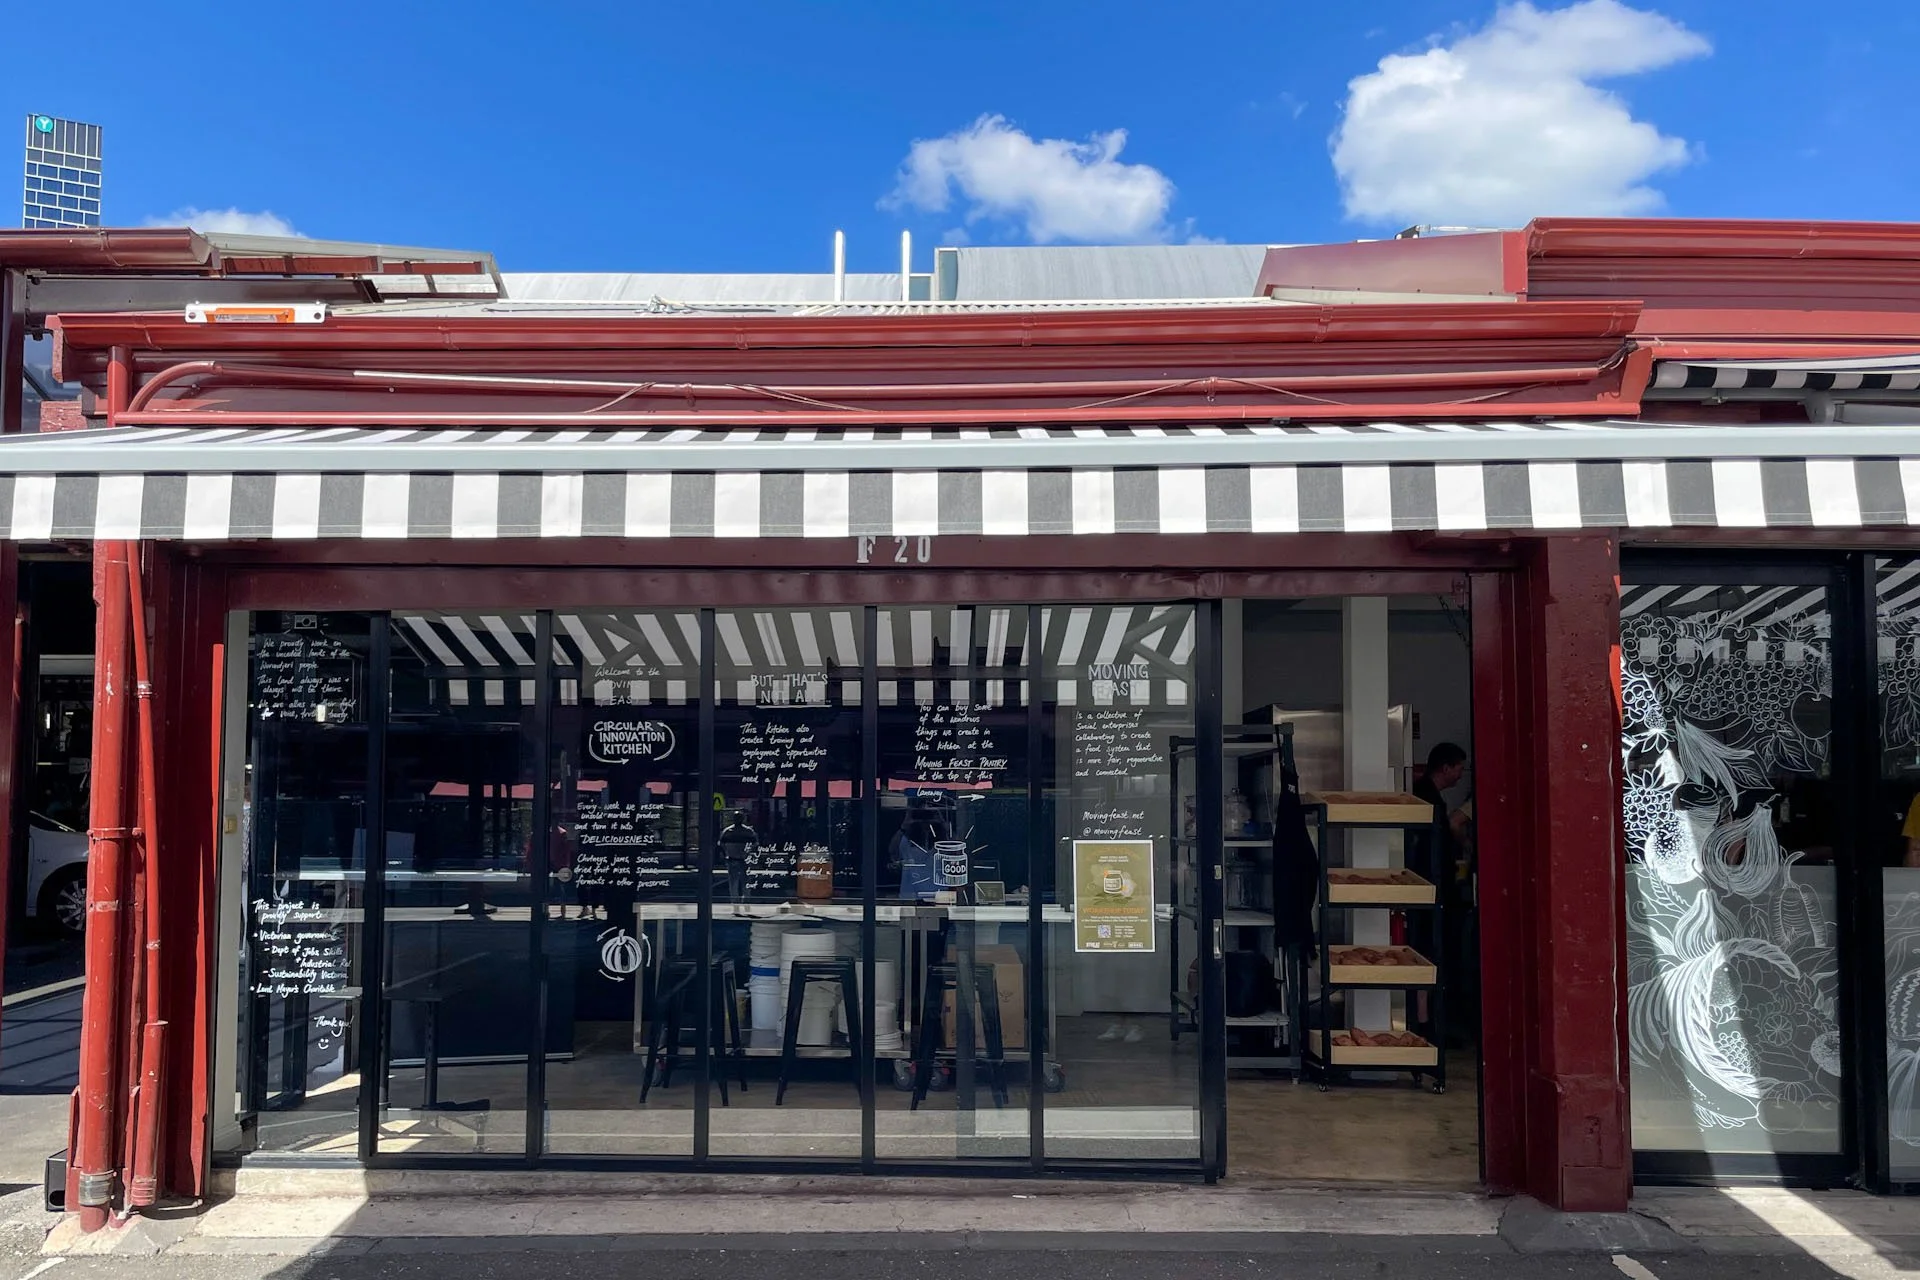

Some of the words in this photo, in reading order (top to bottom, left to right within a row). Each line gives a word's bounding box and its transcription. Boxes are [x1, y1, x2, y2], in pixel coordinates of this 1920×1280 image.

[40, 118, 50, 130] Y
[856, 536, 876, 563] F
[894, 536, 930, 562] 20
[595, 666, 630, 677] Welcome
[1088, 664, 1148, 680] MOVING
[300, 676, 322, 688] always
[750, 674, 774, 688] BUT
[263, 686, 284, 698] always
[955, 702, 968, 716] buy
[594, 721, 654, 732] CIRCULAR
[740, 723, 757, 734] This
[1102, 722, 1138, 732] enterprises
[600, 732, 665, 742] INNOVATION
[916, 726, 938, 740] things
[1130, 731, 1152, 739] create
[603, 744, 652, 755] KITCHEN
[915, 741, 929, 751] this
[937, 741, 960, 750] kitchen
[982, 740, 994, 749] the
[1085, 744, 1101, 755] food
[1106, 745, 1130, 756] system
[1135, 742, 1151, 751] that
[932, 771, 944, 780] the
[948, 771, 959, 781] top
[578, 802, 596, 814] Every
[944, 864, 966, 874] GOOD
[252, 898, 270, 913] This
[259, 930, 292, 941] Victorian
[268, 968, 317, 983] Sustainability
[314, 1016, 338, 1027] Thank
